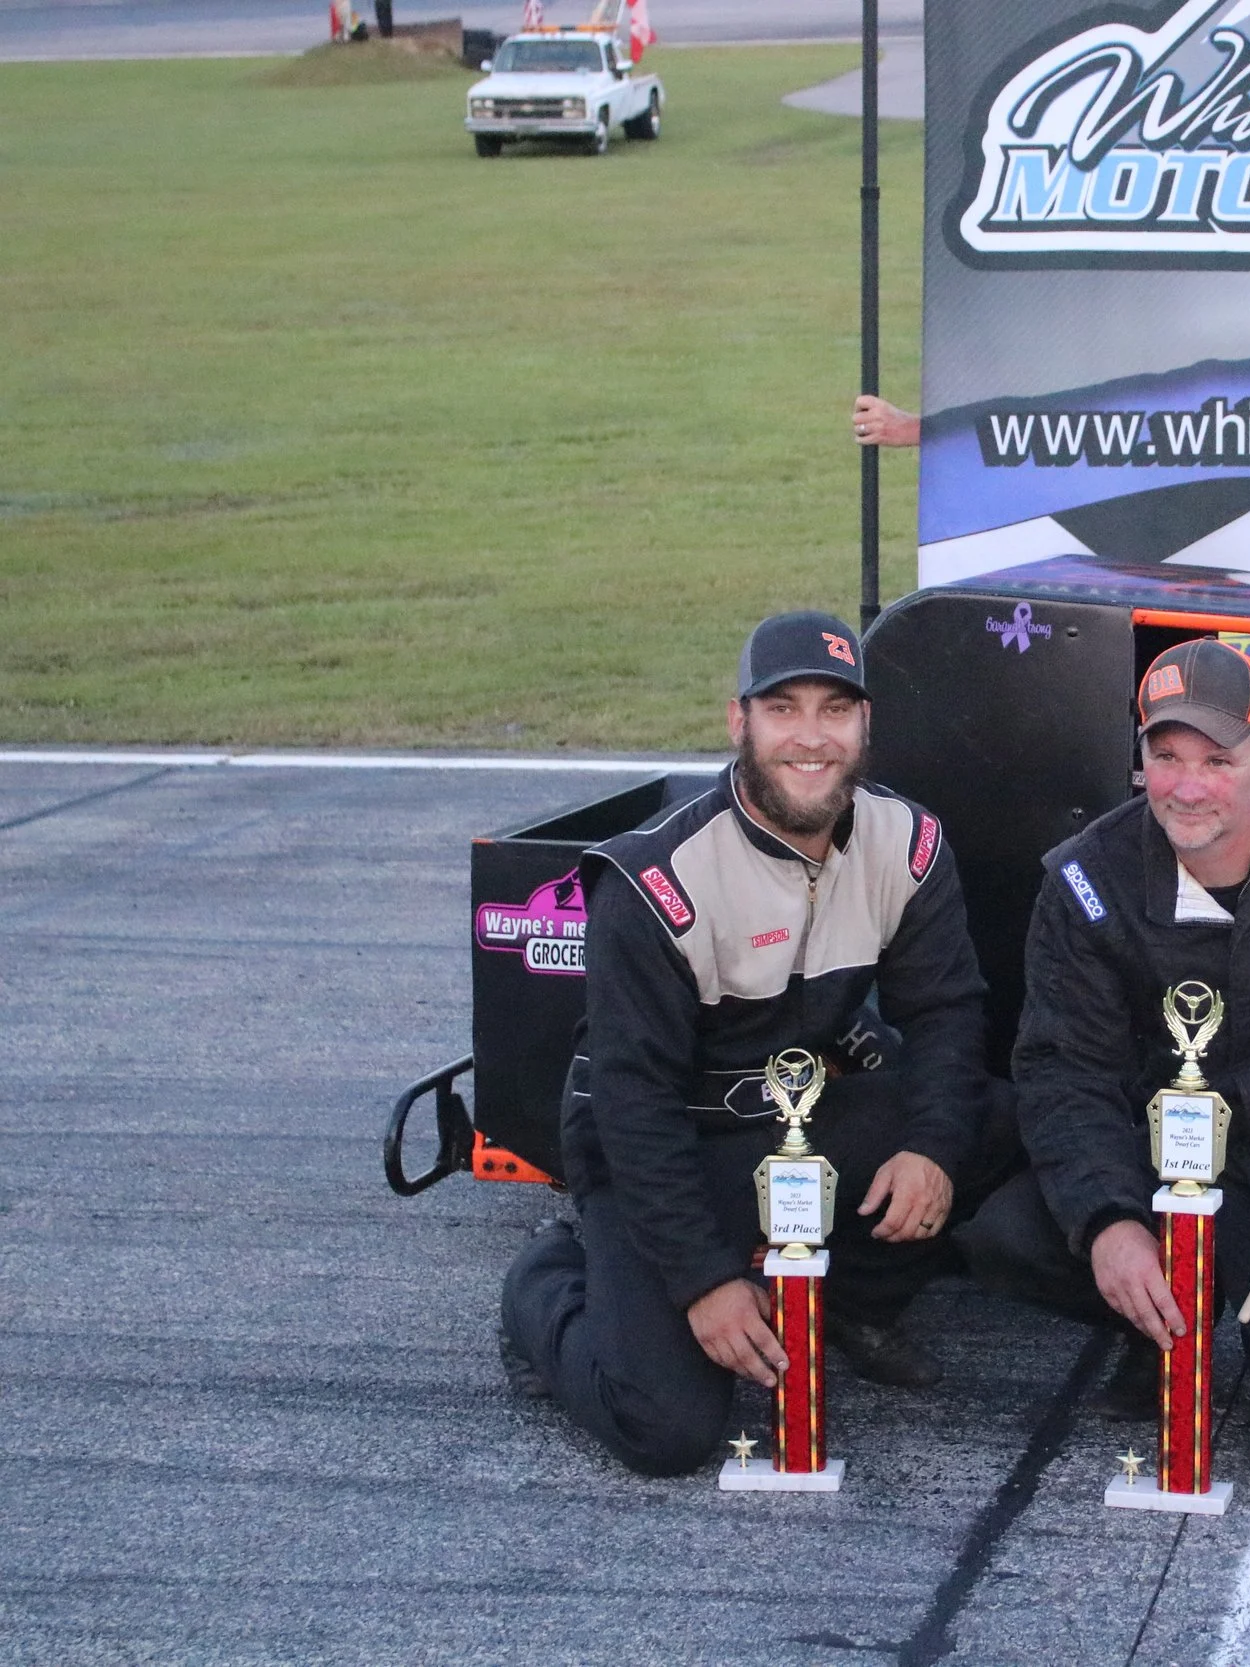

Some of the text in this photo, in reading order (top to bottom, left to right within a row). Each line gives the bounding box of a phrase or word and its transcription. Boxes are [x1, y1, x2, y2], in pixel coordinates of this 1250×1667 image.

[822, 632, 855, 666] 23
[915, 817, 936, 873] SIMPSON
[644, 870, 689, 920] SIMPSON
[1064, 864, 1103, 920] sparco
[485, 911, 587, 940] Wayne's me
[754, 929, 788, 948] SIMPSON
[532, 941, 586, 967] GROCER
[1164, 1159, 1211, 1170] 1st Place
[772, 1224, 821, 1234] 3rd Place
